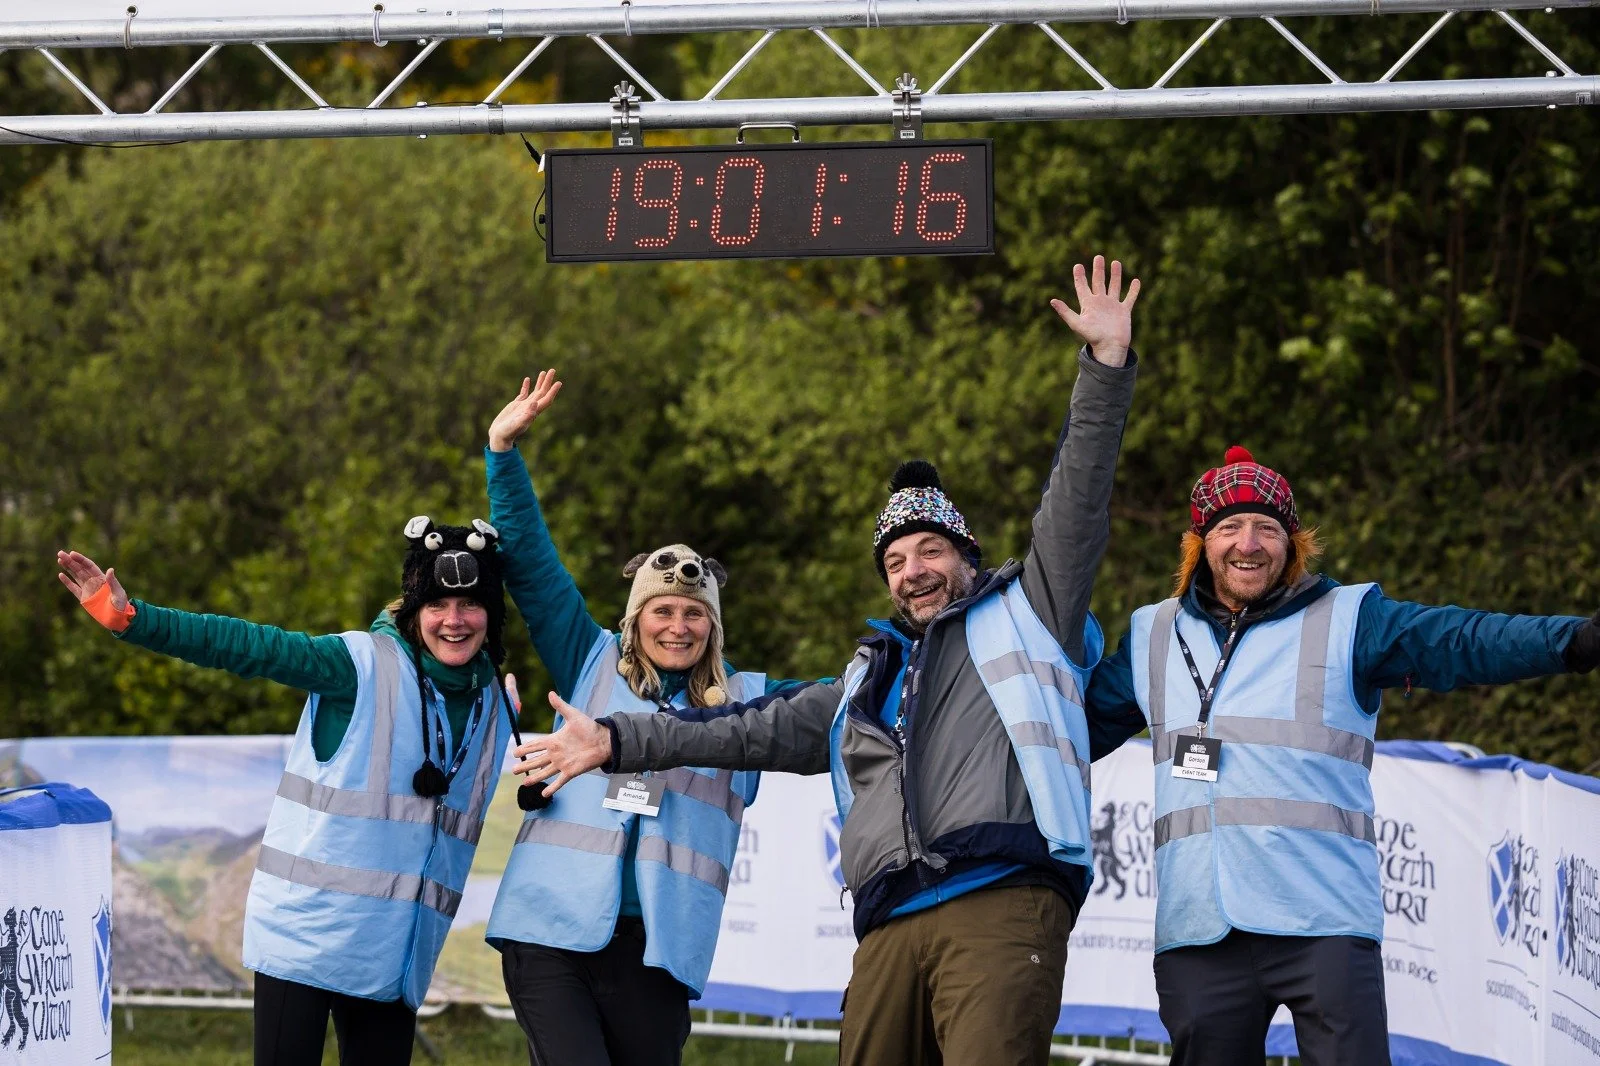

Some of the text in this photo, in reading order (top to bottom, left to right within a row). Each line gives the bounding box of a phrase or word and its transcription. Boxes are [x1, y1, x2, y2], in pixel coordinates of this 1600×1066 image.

[607, 152, 967, 248] 19:01:16
[1188, 756, 1206, 764] Gordon
[622, 791, 646, 801] Amanda
[29, 905, 66, 957] Cape
